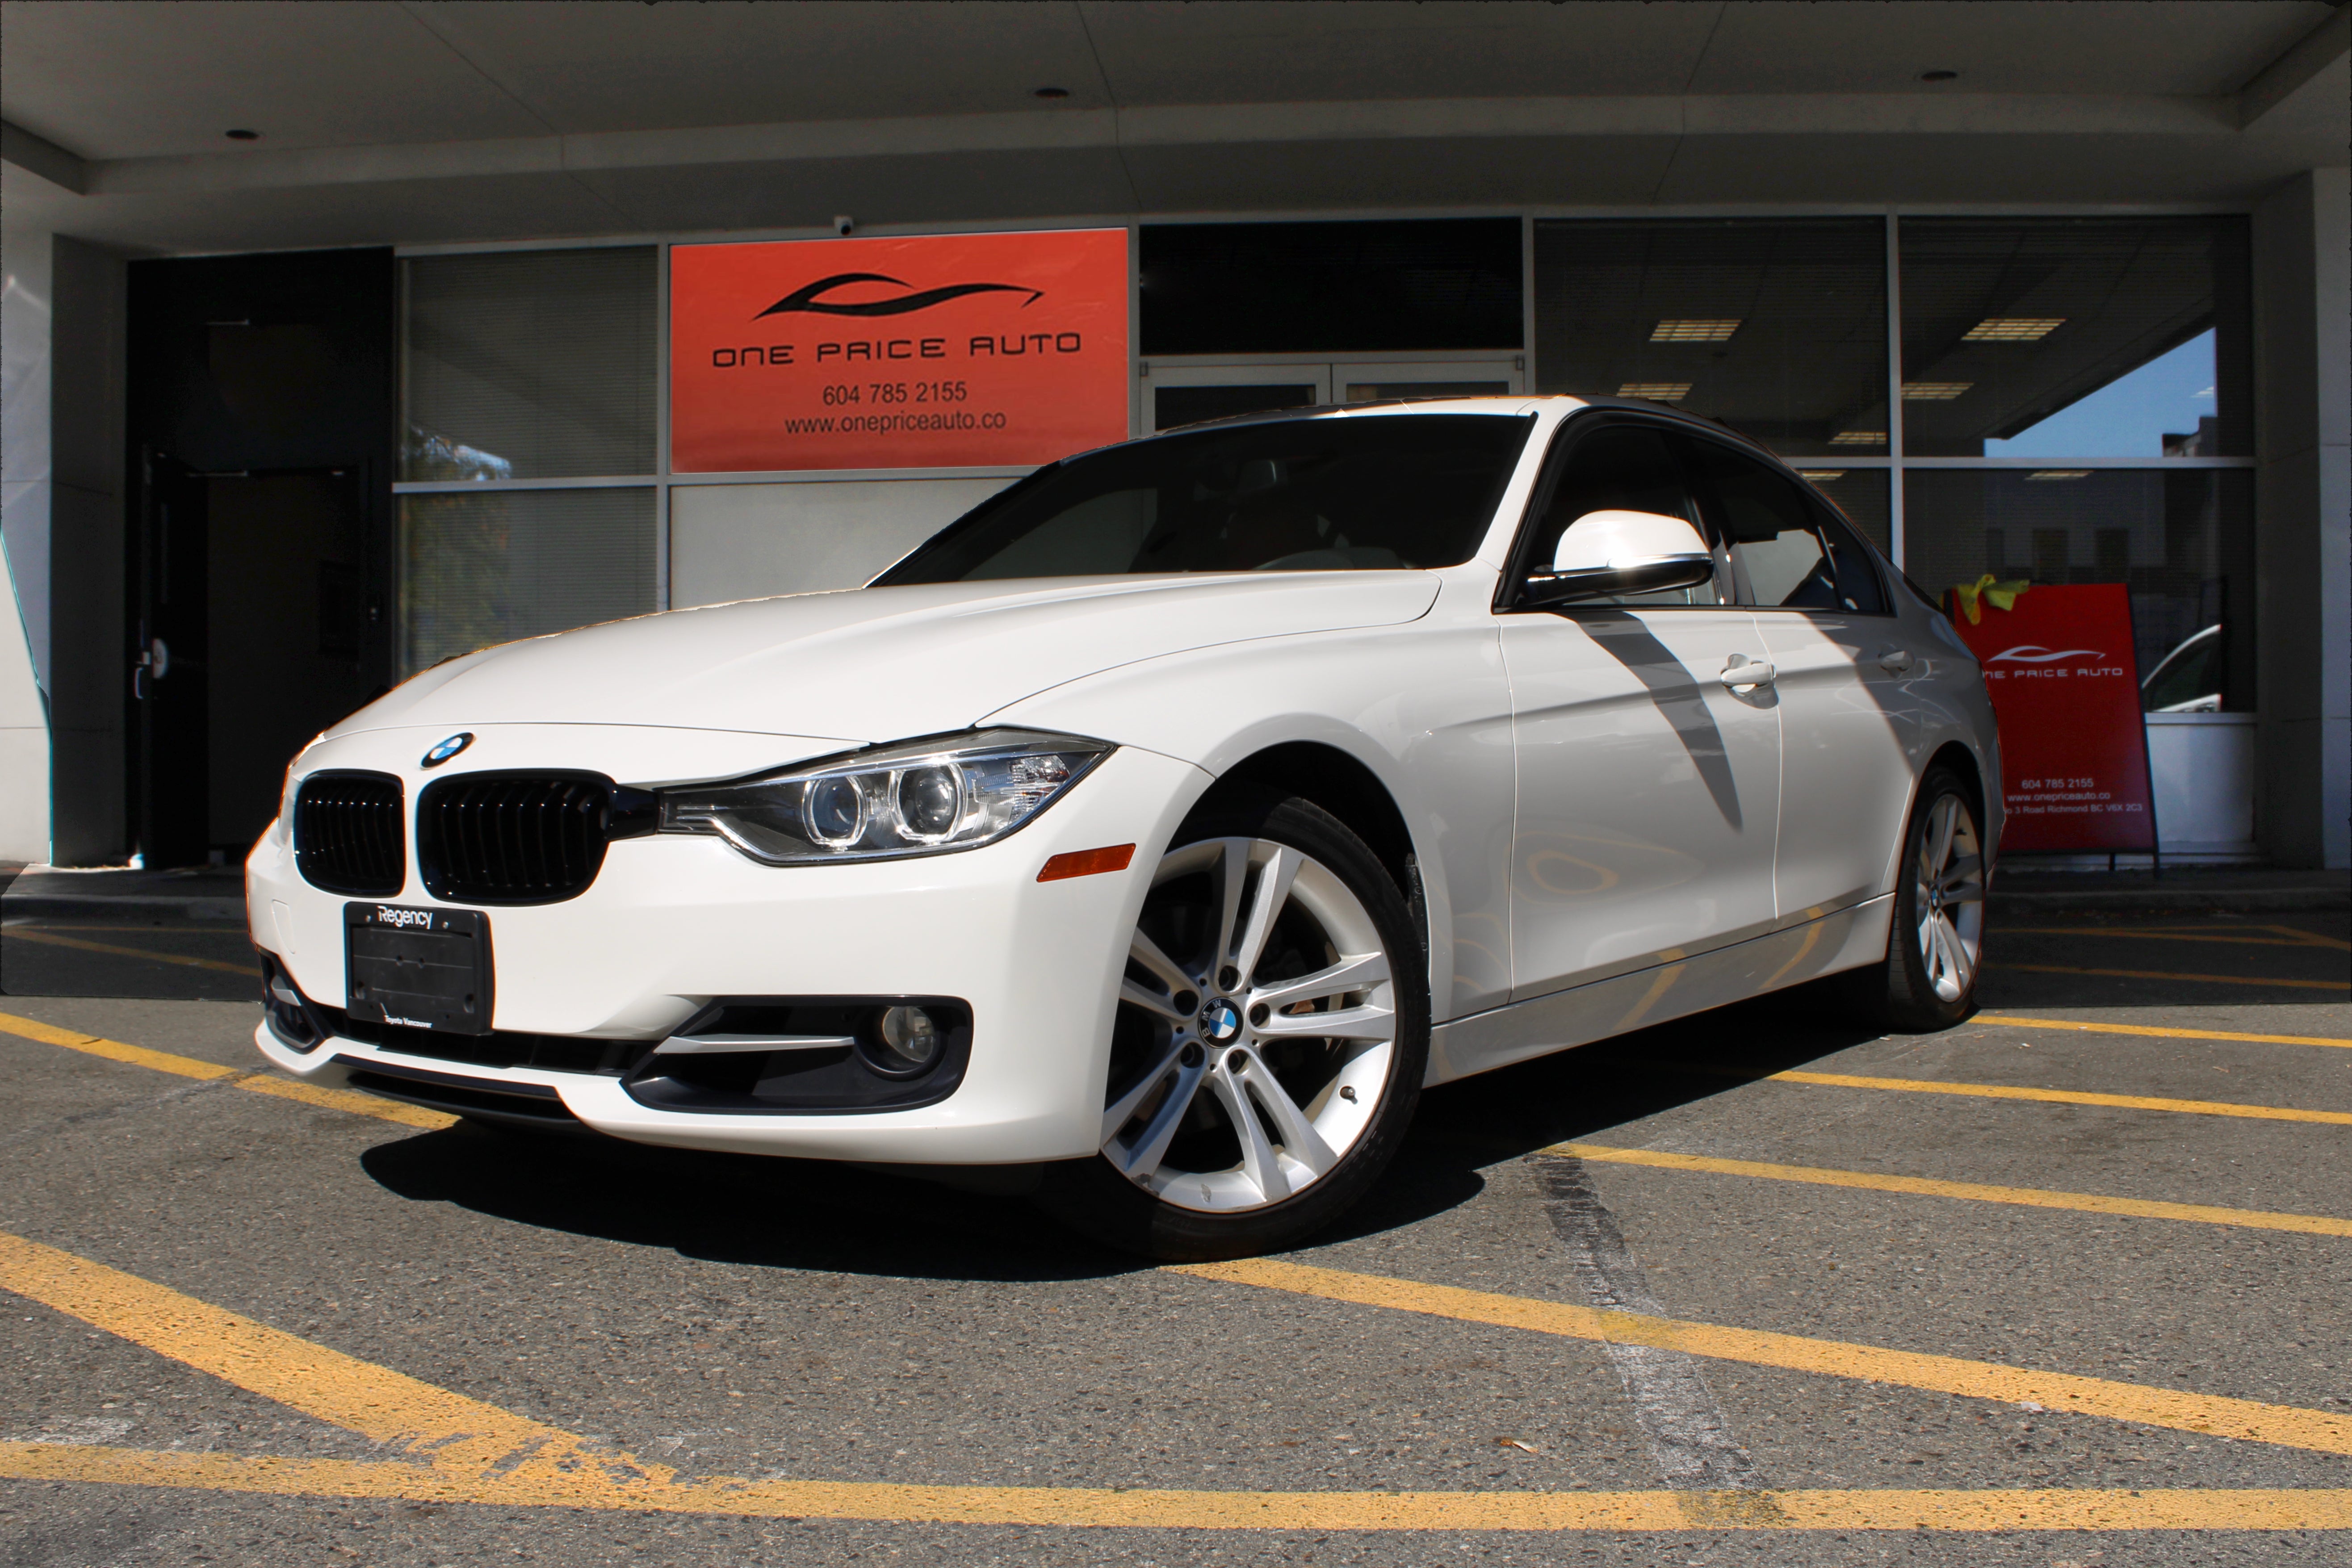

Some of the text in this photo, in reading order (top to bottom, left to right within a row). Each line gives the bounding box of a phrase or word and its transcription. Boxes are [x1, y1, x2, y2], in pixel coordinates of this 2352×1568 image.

[713, 332, 1081, 368] ONE PRICE AUTO
[822, 381, 967, 406] 604 785 2155
[784, 411, 1006, 435] www.onepriceauto.co
[1982, 667, 2123, 679] NE PRICE AUTO
[2021, 778, 2094, 789] 604 785 2155
[2007, 792, 2111, 802] www.onepriceauto.co
[2015, 806, 2021, 814] 3
[2047, 805, 2088, 813] Richmond
[2090, 804, 2103, 812] BC
[2126, 803, 2143, 811] 2C3
[377, 905, 434, 930] Regency
[384, 1015, 432, 1028] Toyota Vancouver
